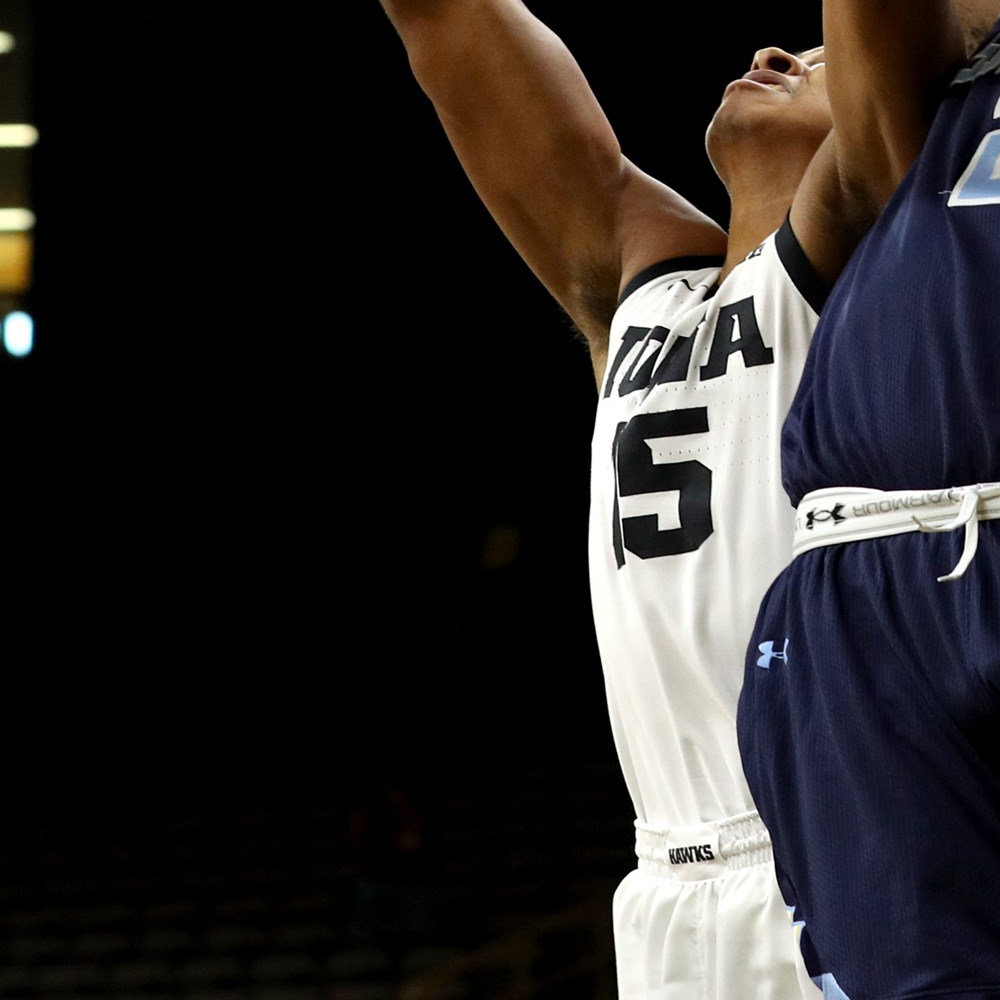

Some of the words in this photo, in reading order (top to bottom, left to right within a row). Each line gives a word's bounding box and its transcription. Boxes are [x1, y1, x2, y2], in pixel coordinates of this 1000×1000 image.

[611, 406, 714, 570] 15
[852, 490, 944, 518] ARMOUR
[668, 844, 715, 865] HAWKS
